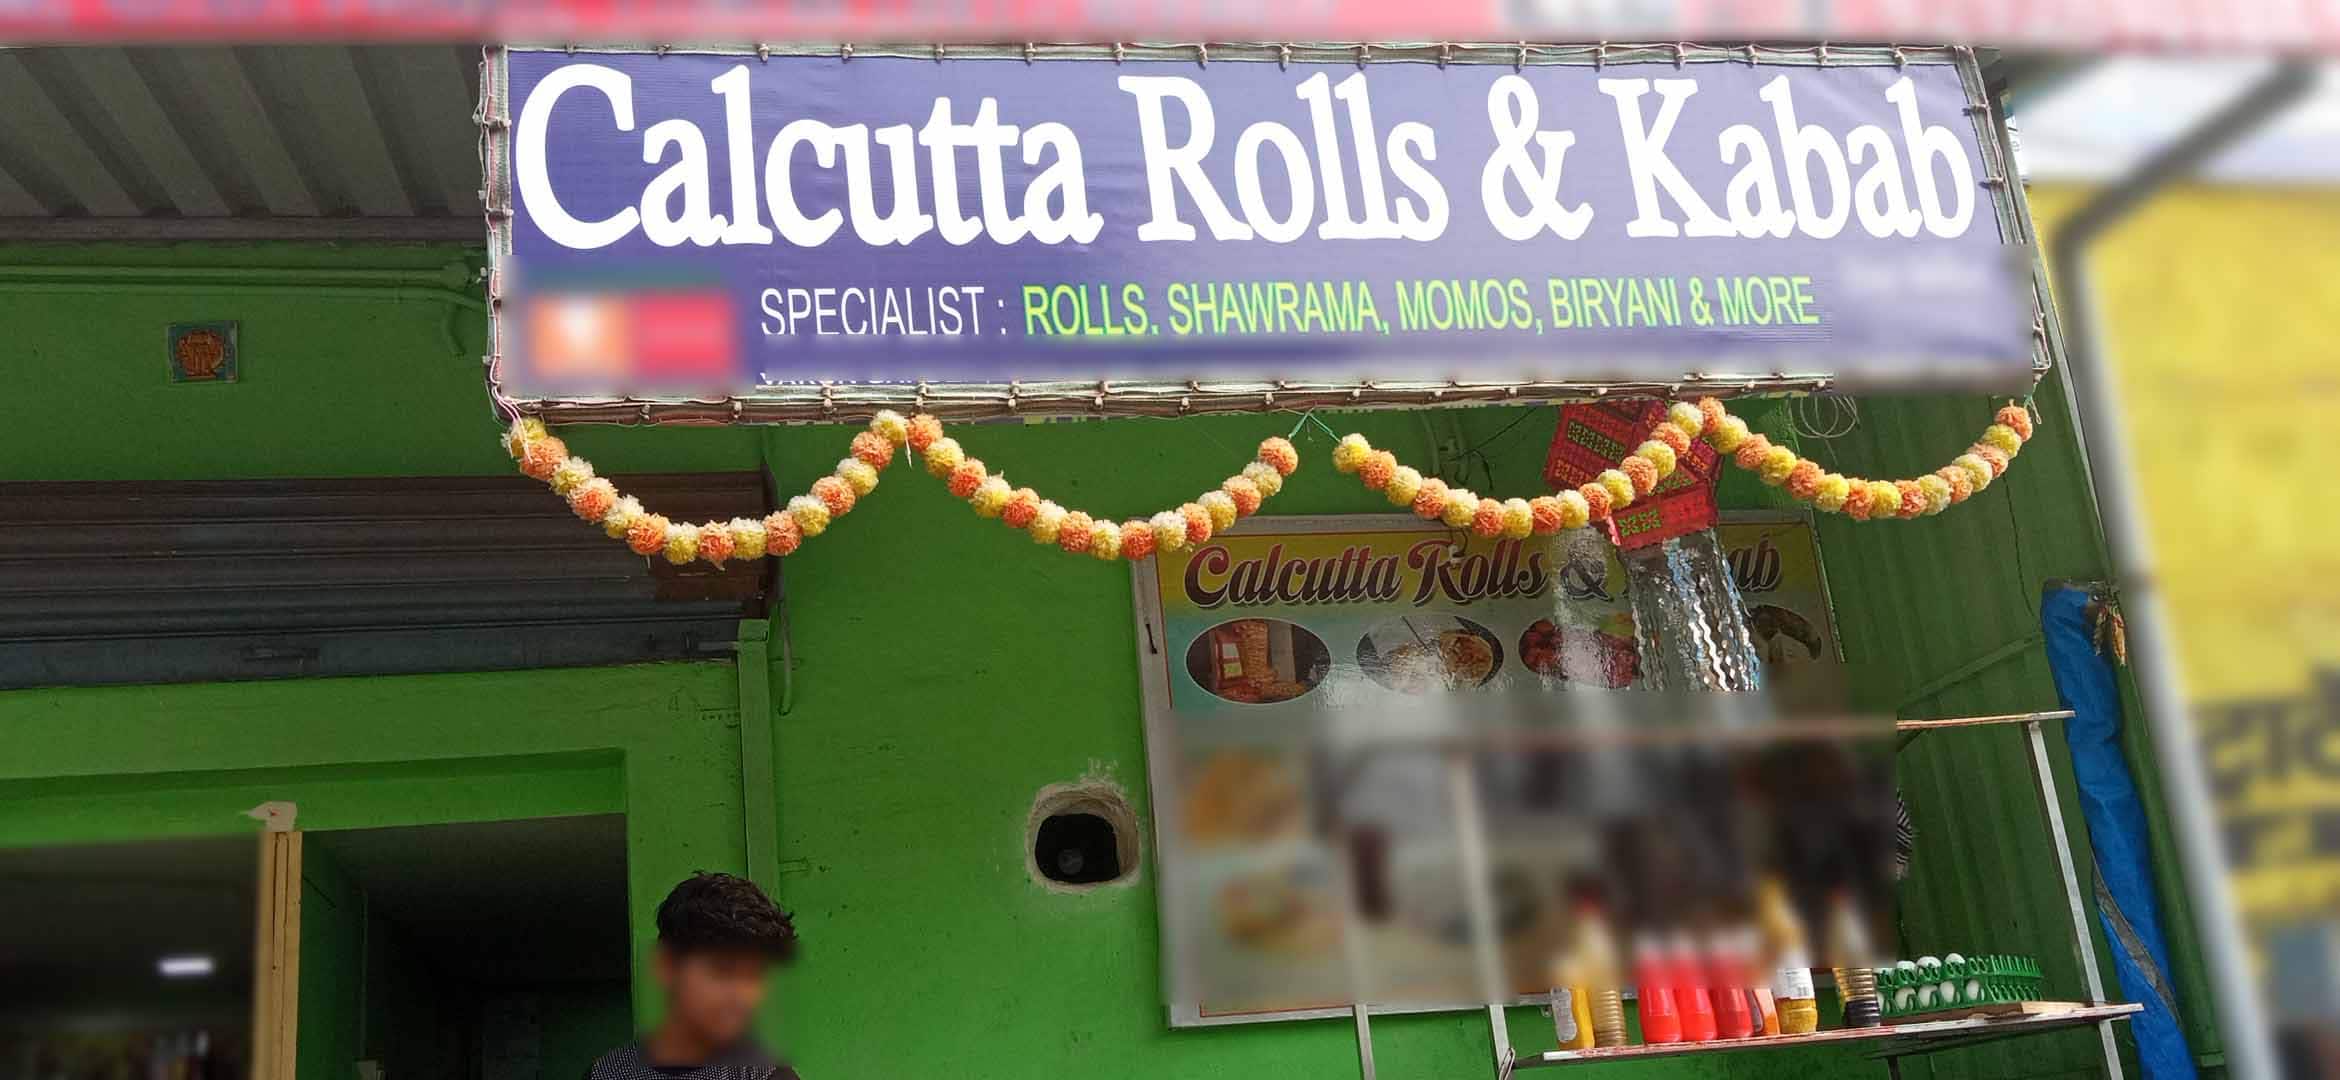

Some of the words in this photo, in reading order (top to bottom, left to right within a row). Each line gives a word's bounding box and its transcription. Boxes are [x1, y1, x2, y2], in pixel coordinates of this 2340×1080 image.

[515, 63, 1105, 250] Calcutta
[1117, 70, 1451, 244] Rolls
[1480, 74, 1595, 242] &
[1598, 74, 1976, 240] Kabab
[760, 285, 986, 335] SPECIALIST
[1167, 280, 1391, 335] SHAWRAMA,
[1395, 277, 1545, 334] MOMOS,
[1547, 276, 1682, 328] BIRYANI
[1688, 275, 1715, 326] &
[1716, 274, 1820, 326] MORE
[1184, 542, 1402, 608] Calcutta
[1407, 538, 1549, 608] Rolls
